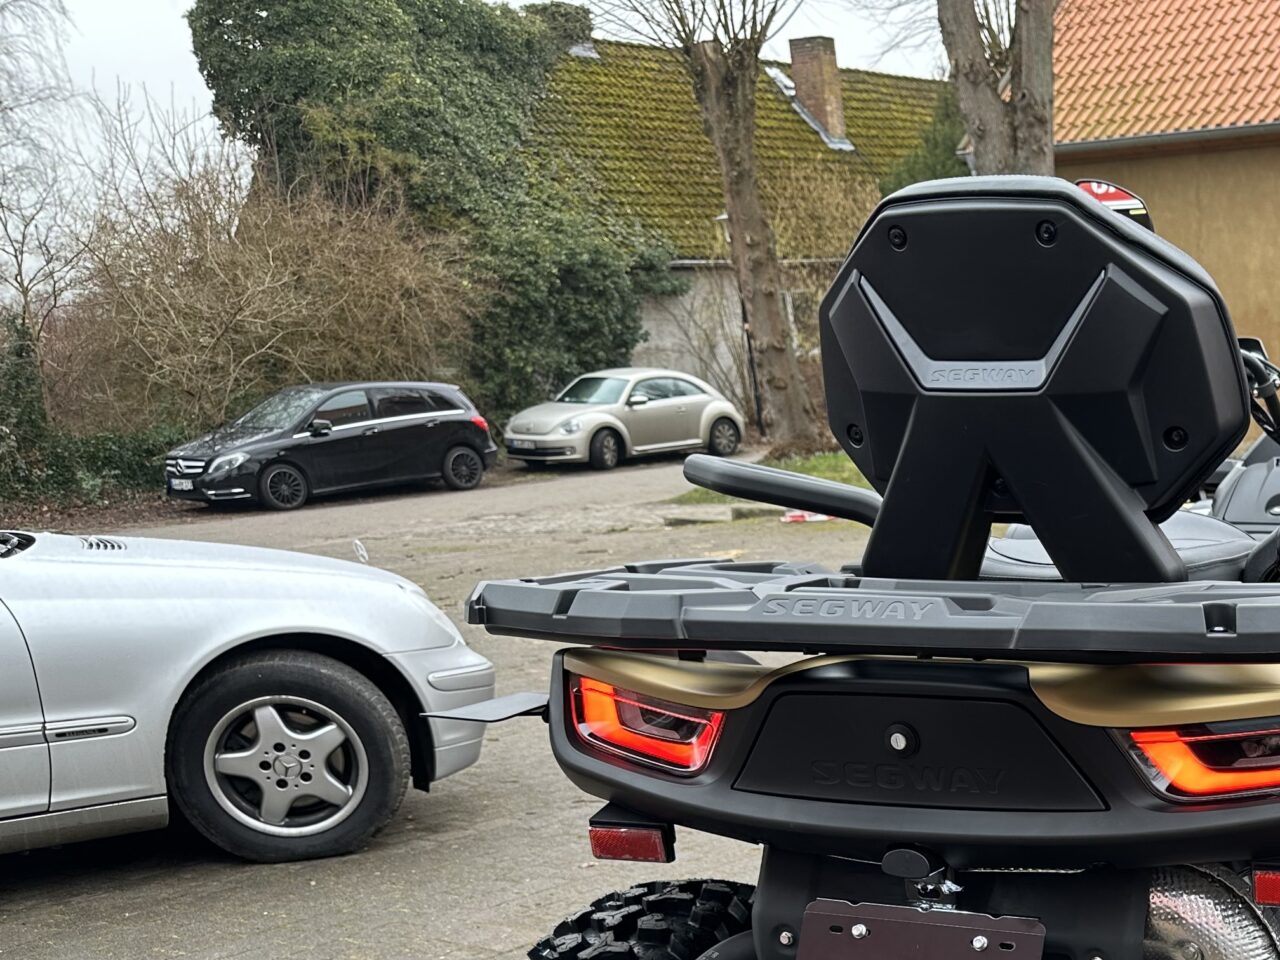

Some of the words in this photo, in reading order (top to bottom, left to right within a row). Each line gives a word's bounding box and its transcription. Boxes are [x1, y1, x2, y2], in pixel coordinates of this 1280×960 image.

[931, 368, 1036, 383] SEGWAY
[762, 598, 935, 621] SEGWAY
[811, 759, 1006, 795] SEGWAY
